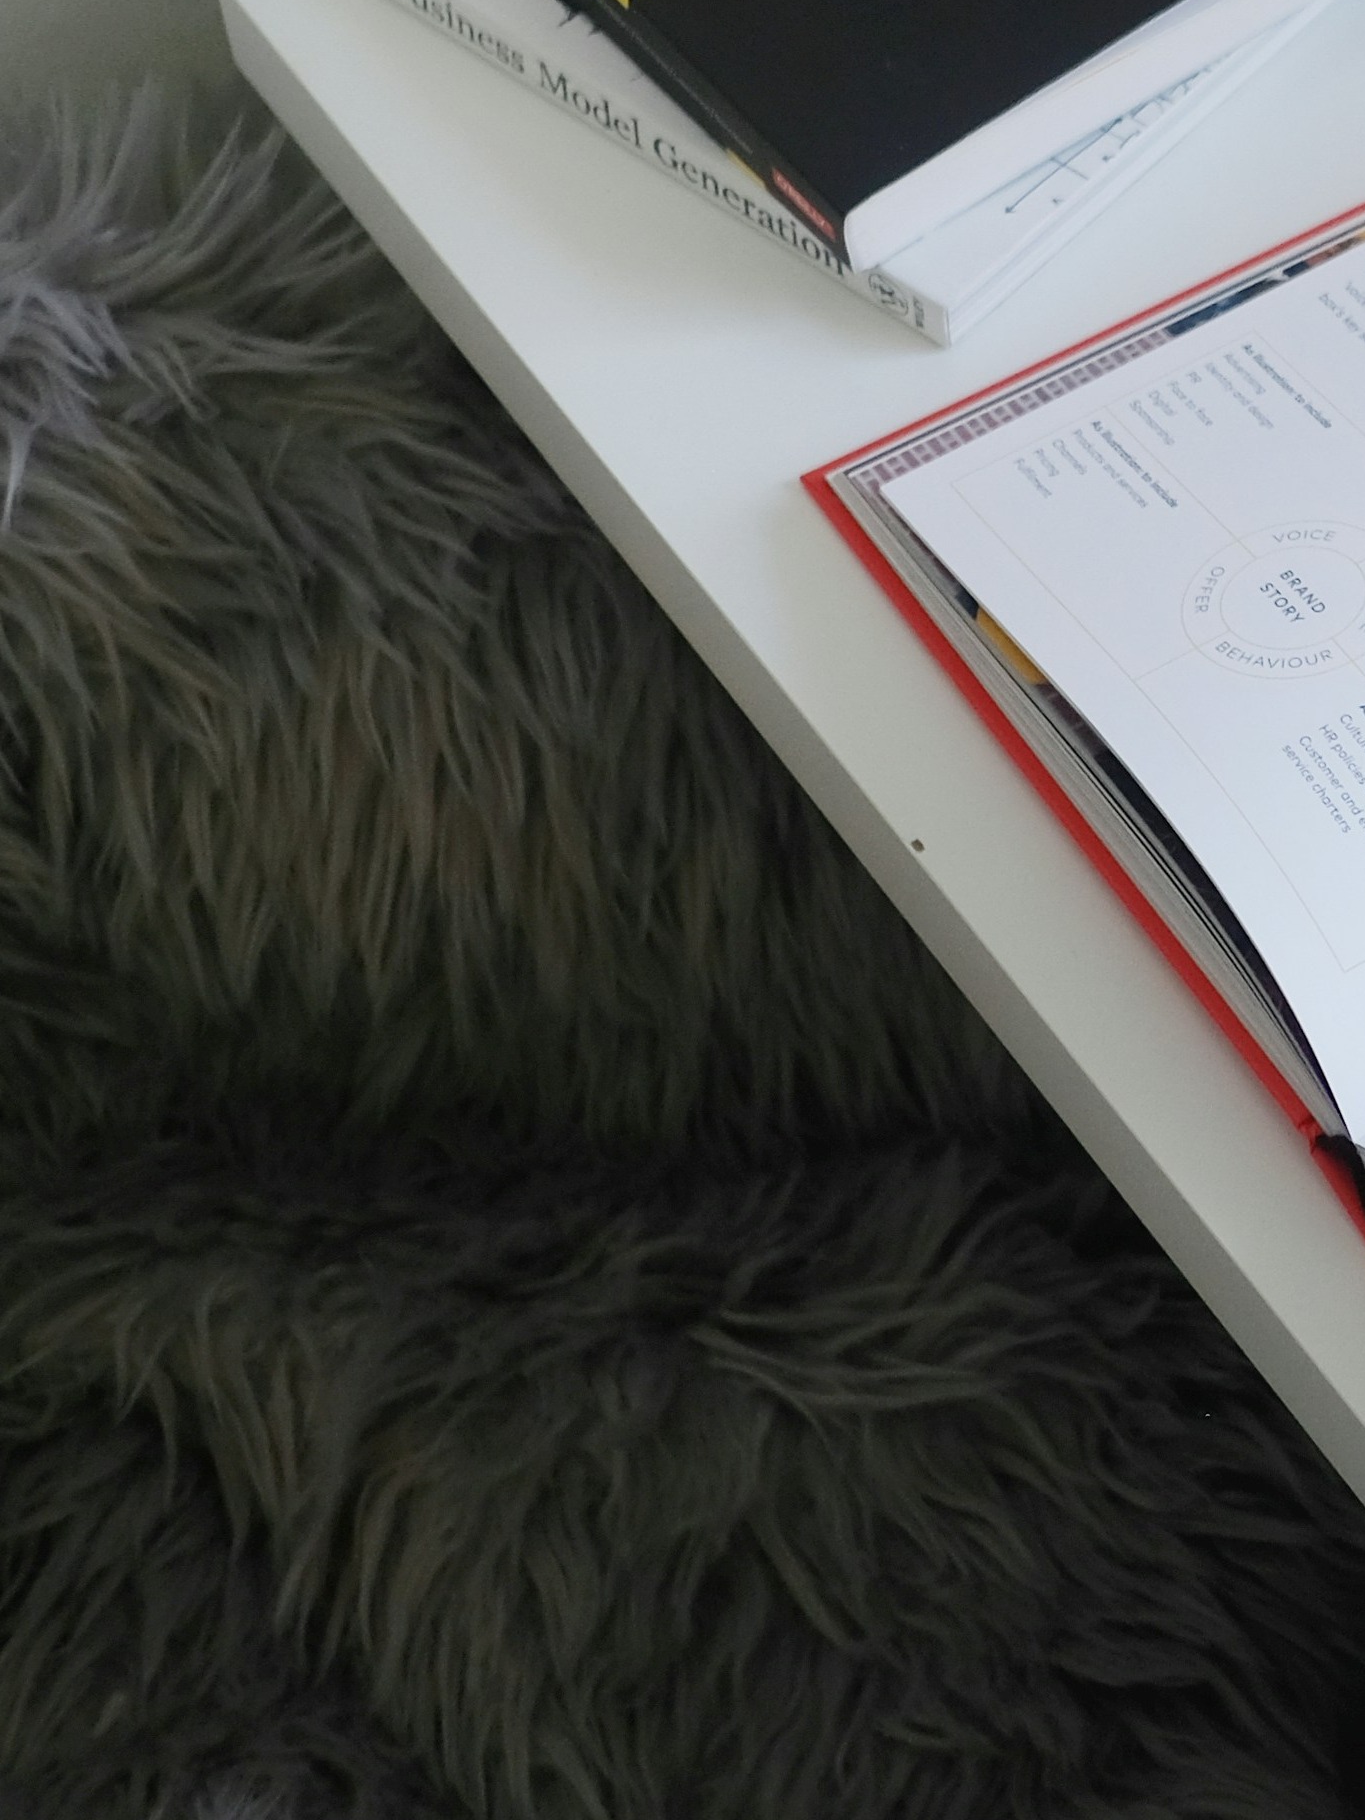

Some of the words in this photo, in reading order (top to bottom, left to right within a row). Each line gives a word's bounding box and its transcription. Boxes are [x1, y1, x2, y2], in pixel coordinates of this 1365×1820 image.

[537, 58, 642, 149] Model
[652, 136, 848, 278] Generation
[1259, 581, 1306, 623] STORY
[1278, 567, 1326, 615] BRAND
